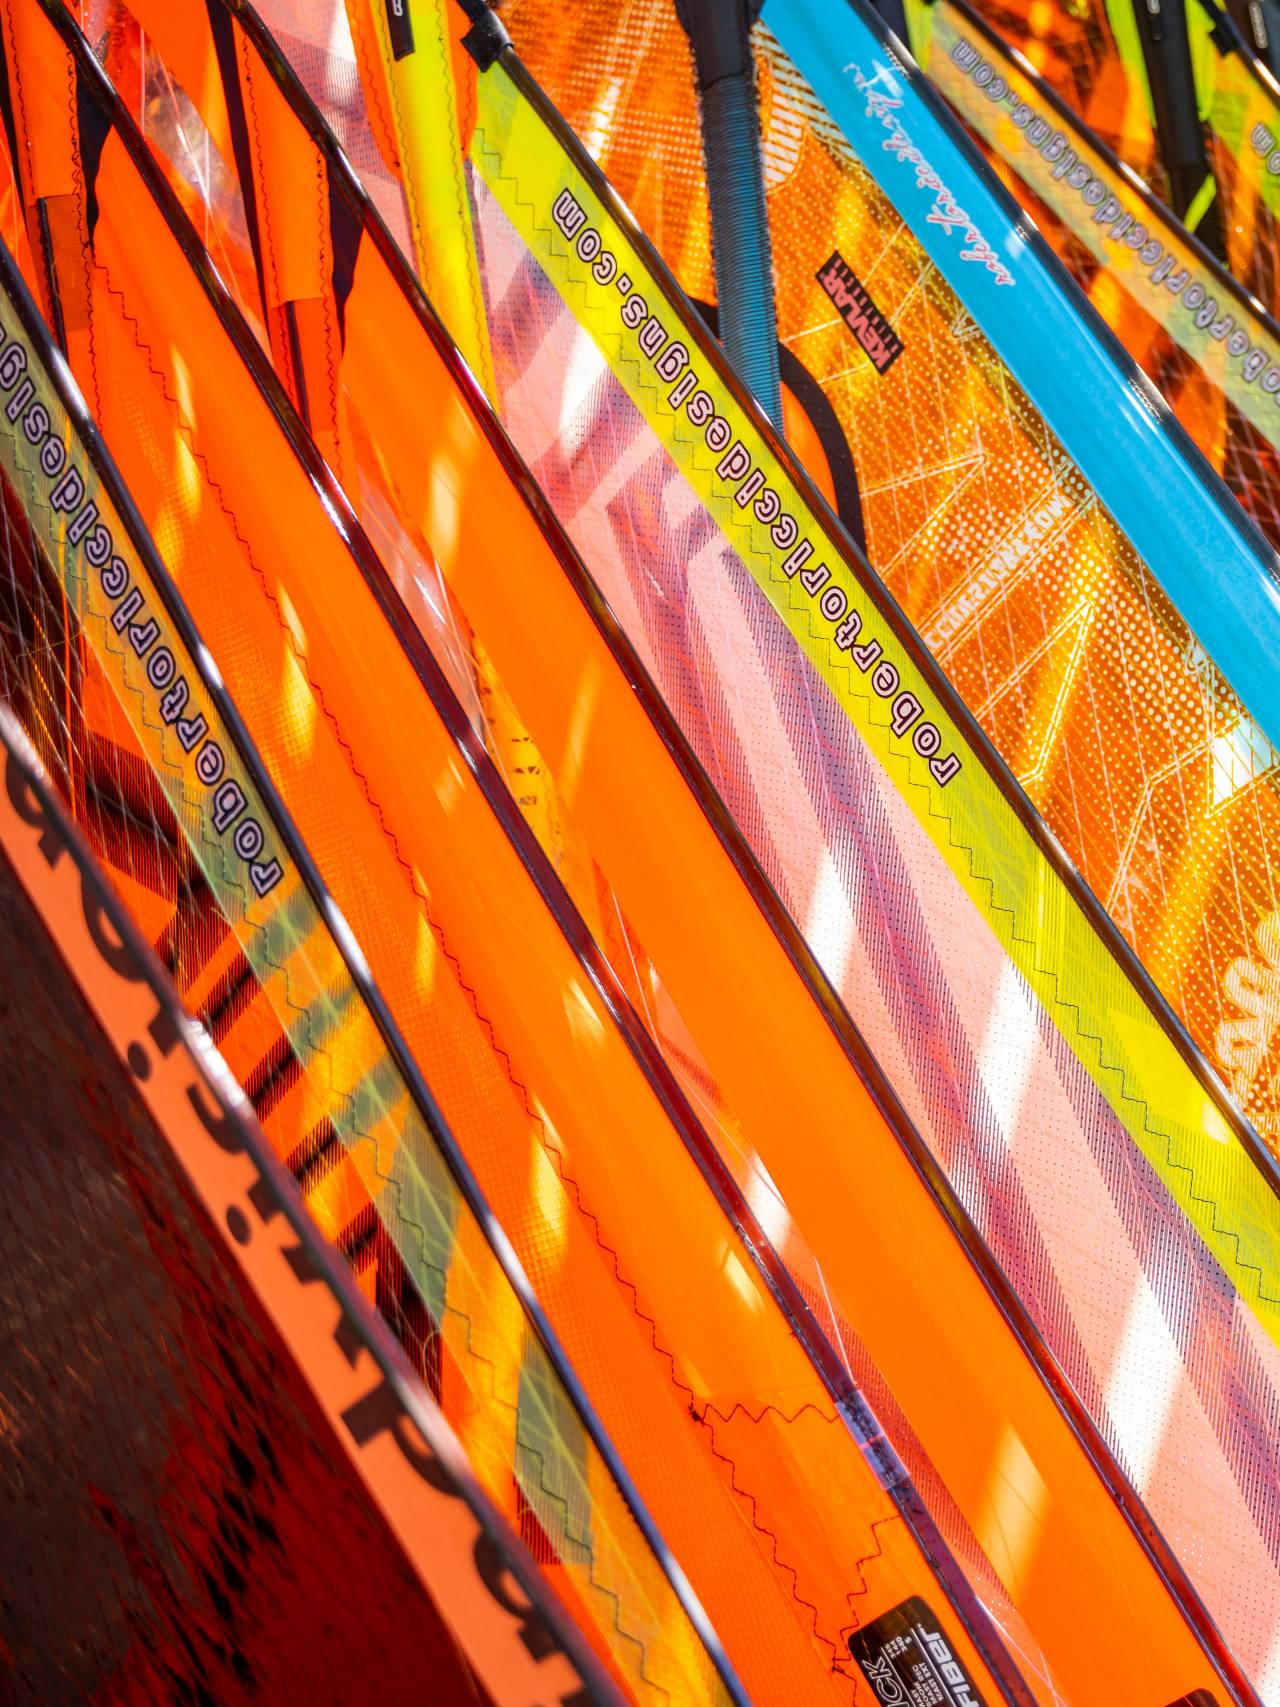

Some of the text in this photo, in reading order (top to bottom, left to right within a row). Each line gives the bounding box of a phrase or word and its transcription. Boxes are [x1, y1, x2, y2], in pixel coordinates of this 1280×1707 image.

[819, 266, 892, 369] KEVLAR
[552, 188, 961, 787] robertoriccidesigns.com
[0, 322, 284, 898] robertoriccidesig
[885, 1643, 896, 1659] 345
[891, 1640, 901, 1655] 144
[896, 1636, 936, 1705] MAST REC 340
[919, 1662, 931, 1678] EXT
[930, 1678, 944, 1701] MAST
